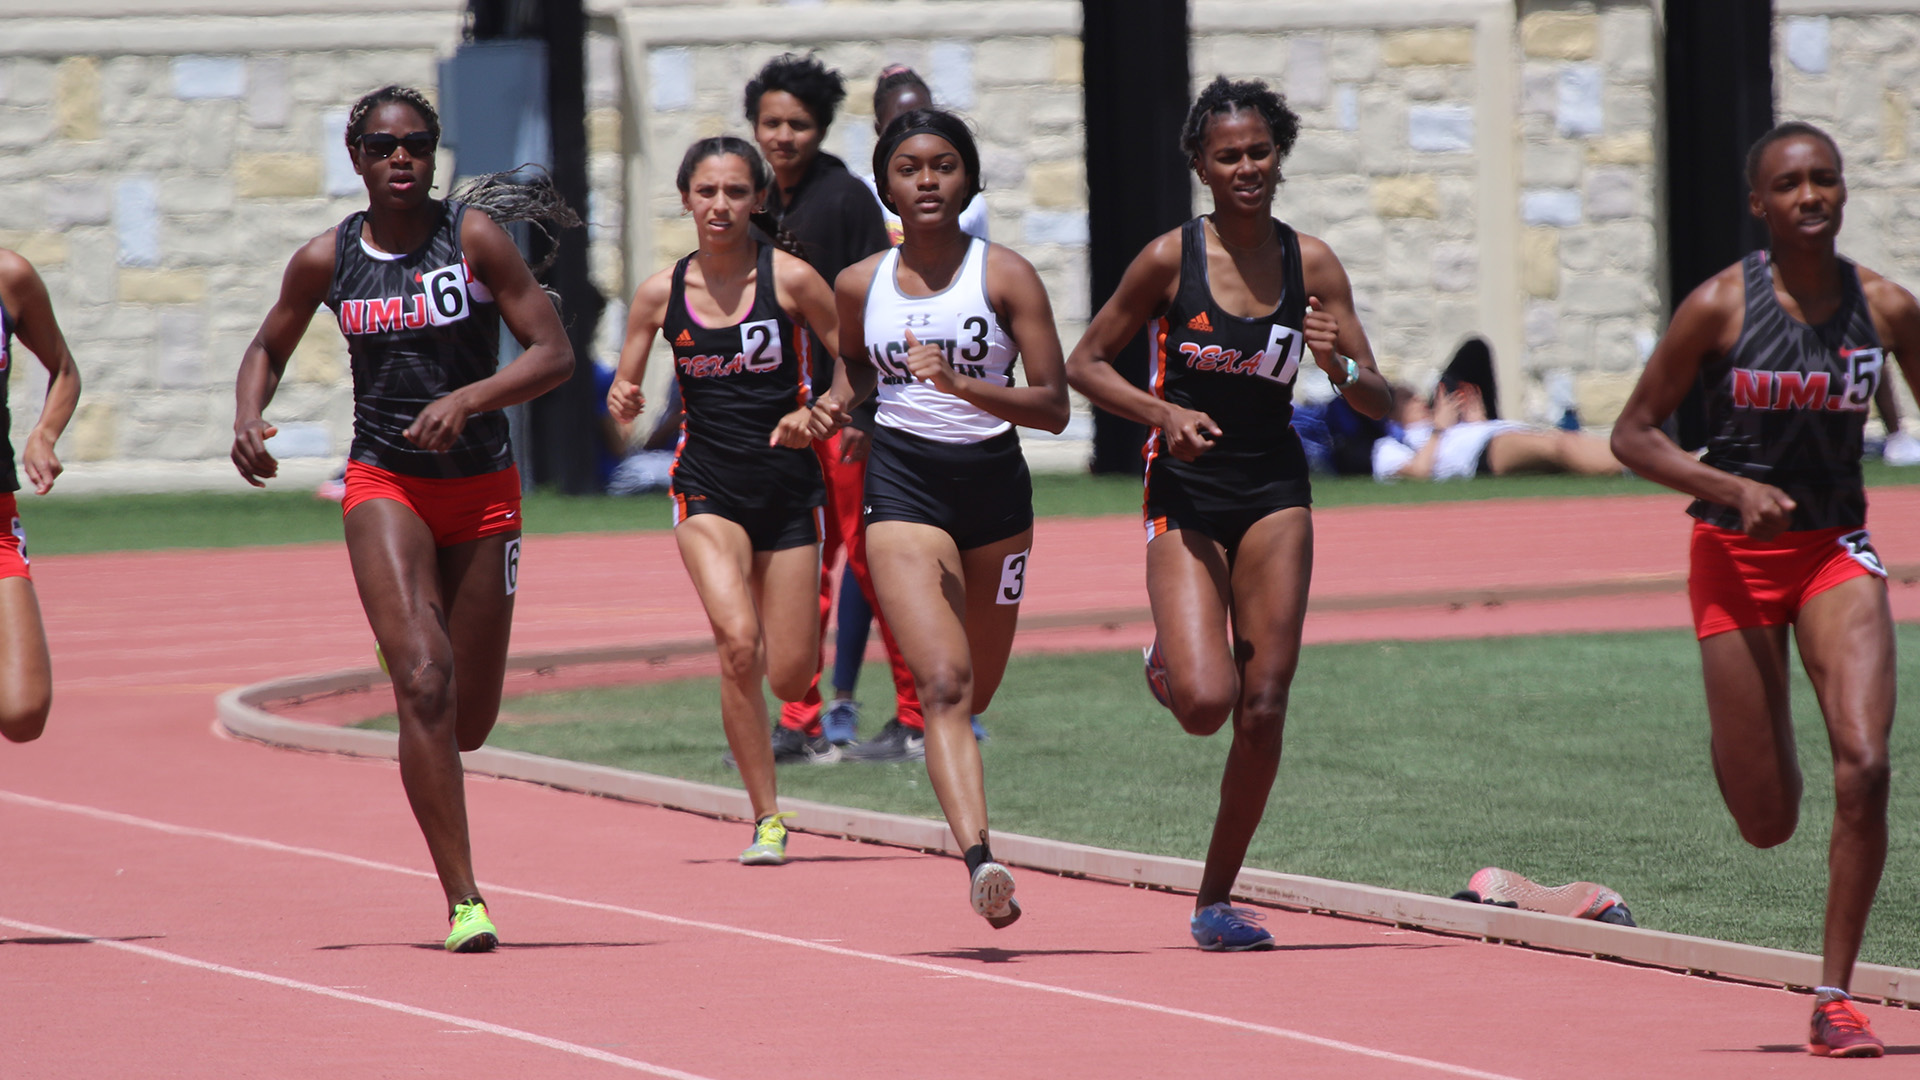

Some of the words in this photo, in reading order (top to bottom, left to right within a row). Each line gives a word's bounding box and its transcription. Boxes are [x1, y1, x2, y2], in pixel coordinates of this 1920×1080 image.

[341, 293, 436, 335] NMJ
[431, 271, 464, 318] 6
[746, 325, 776, 366] 2
[961, 316, 989, 362] 3
[1179, 342, 1266, 376] TEXA
[1271, 332, 1295, 378] 1
[678, 352, 779, 378] TEXA
[1850, 353, 1876, 405] 5
[508, 542, 520, 589] 6
[1004, 555, 1026, 601] 3
